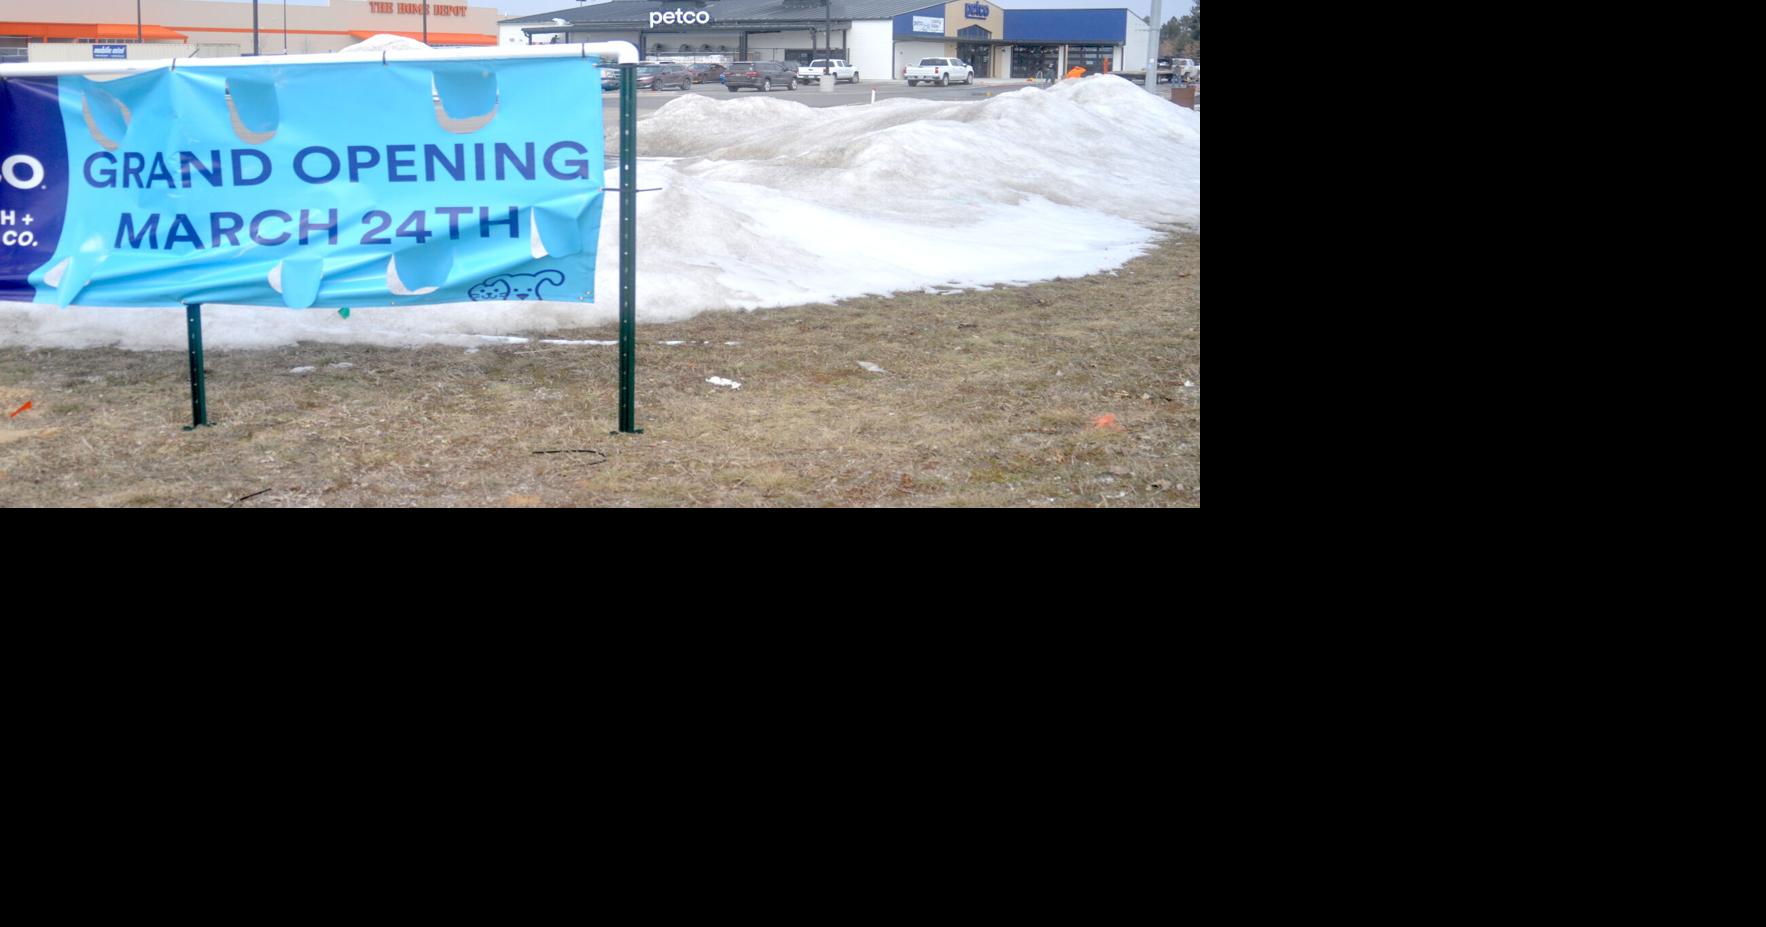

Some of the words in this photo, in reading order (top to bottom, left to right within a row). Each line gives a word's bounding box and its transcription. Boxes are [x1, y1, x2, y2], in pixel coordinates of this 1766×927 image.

[649, 8, 710, 28] petco
[83, 148, 272, 189] GRAND
[292, 140, 590, 185] OPENING
[2, 230, 38, 247] CO.
[114, 208, 338, 250] MARCH
[360, 206, 520, 245] 24TH
